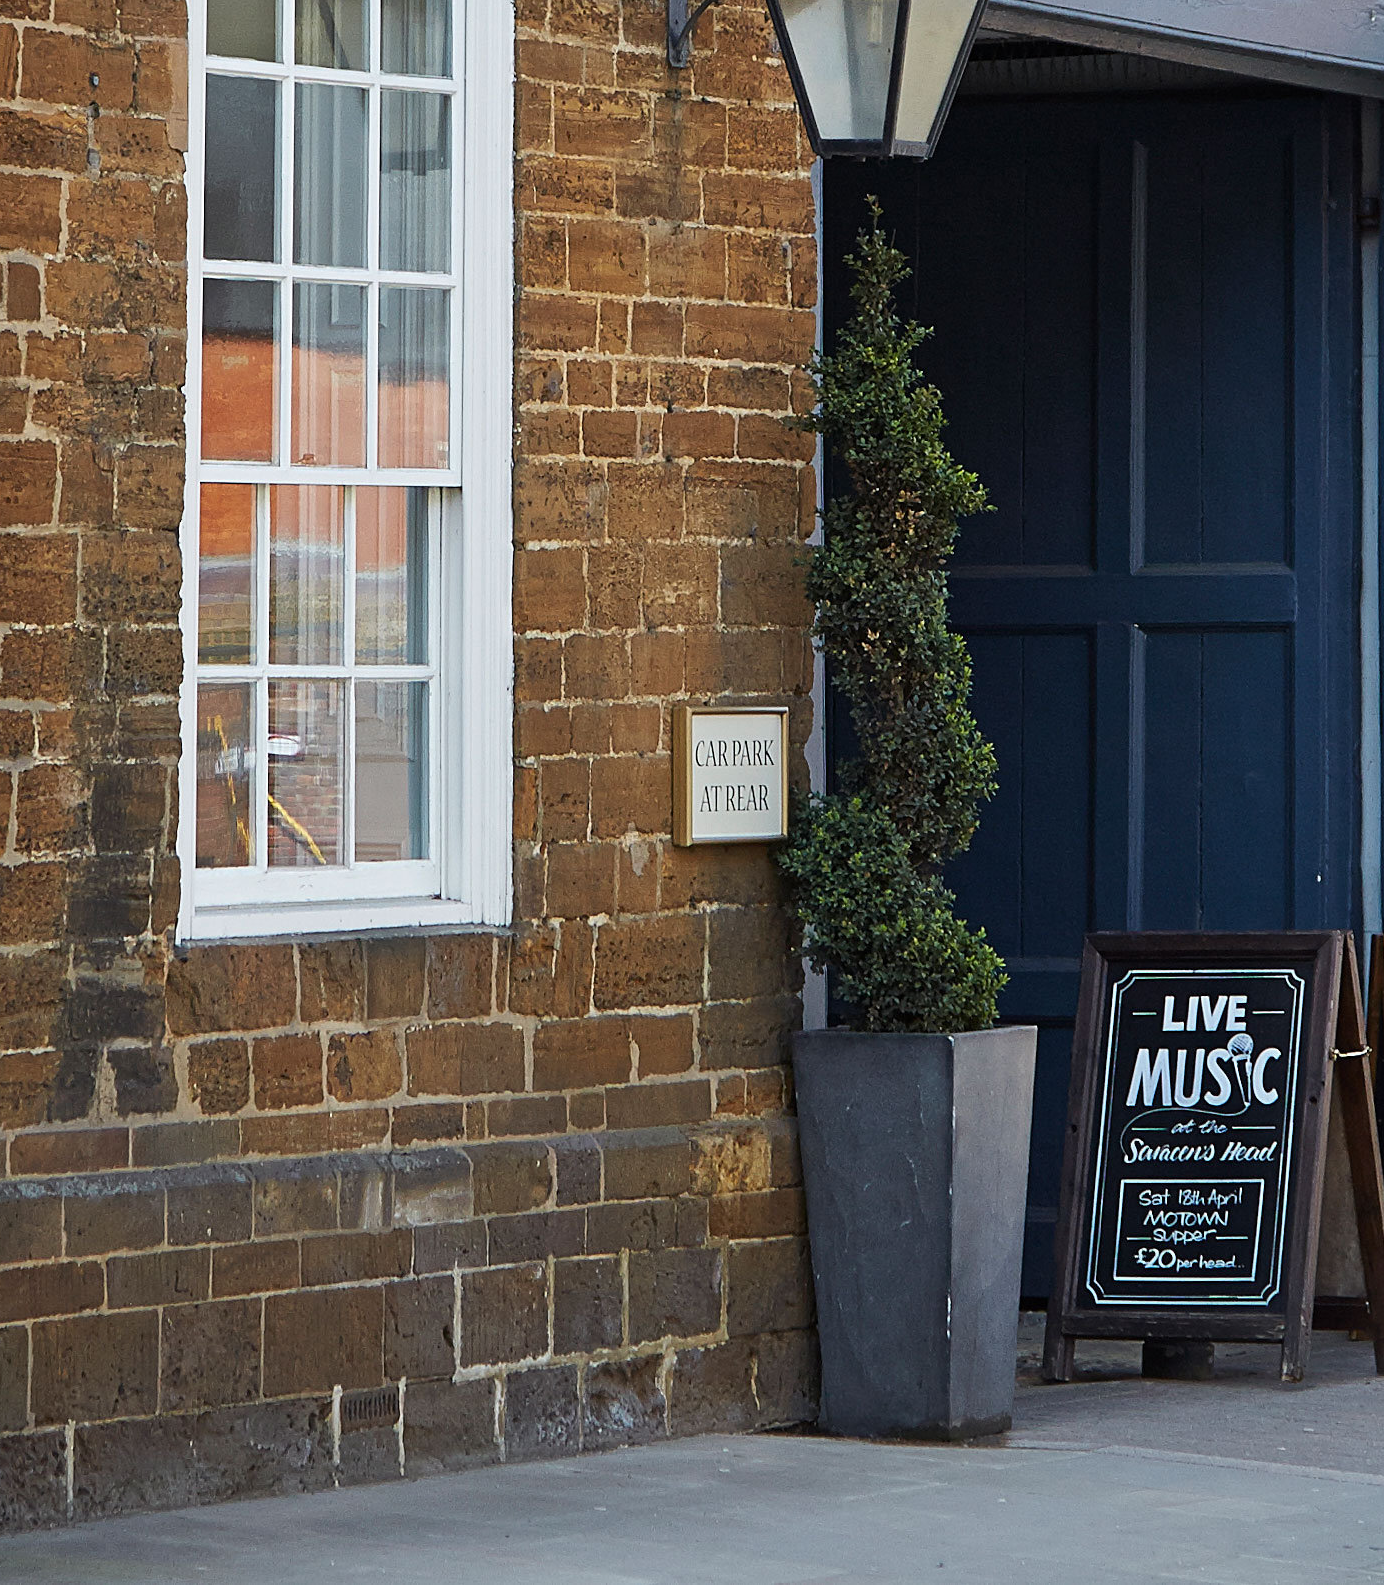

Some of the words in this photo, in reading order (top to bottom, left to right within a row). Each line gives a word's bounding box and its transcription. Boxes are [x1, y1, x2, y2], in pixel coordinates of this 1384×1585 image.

[694, 740, 729, 767] CAR
[732, 739, 775, 766] PARK
[699, 785, 723, 812] AT
[726, 784, 770, 811] REAR
[1162, 995, 1248, 1031] LIVE
[1125, 1045, 1282, 1108] MUSIC
[1170, 1119, 1196, 1135] at
[1199, 1119, 1228, 1135] the
[1220, 1141, 1278, 1162] Head
[1138, 1189, 1170, 1207] Sat
[1178, 1188, 1206, 1206] 18th
[1207, 1187, 1243, 1209] April
[1143, 1210, 1229, 1227] MOTOWN
[1133, 1247, 1176, 1269] £20
[1176, 1257, 1198, 1272] per
